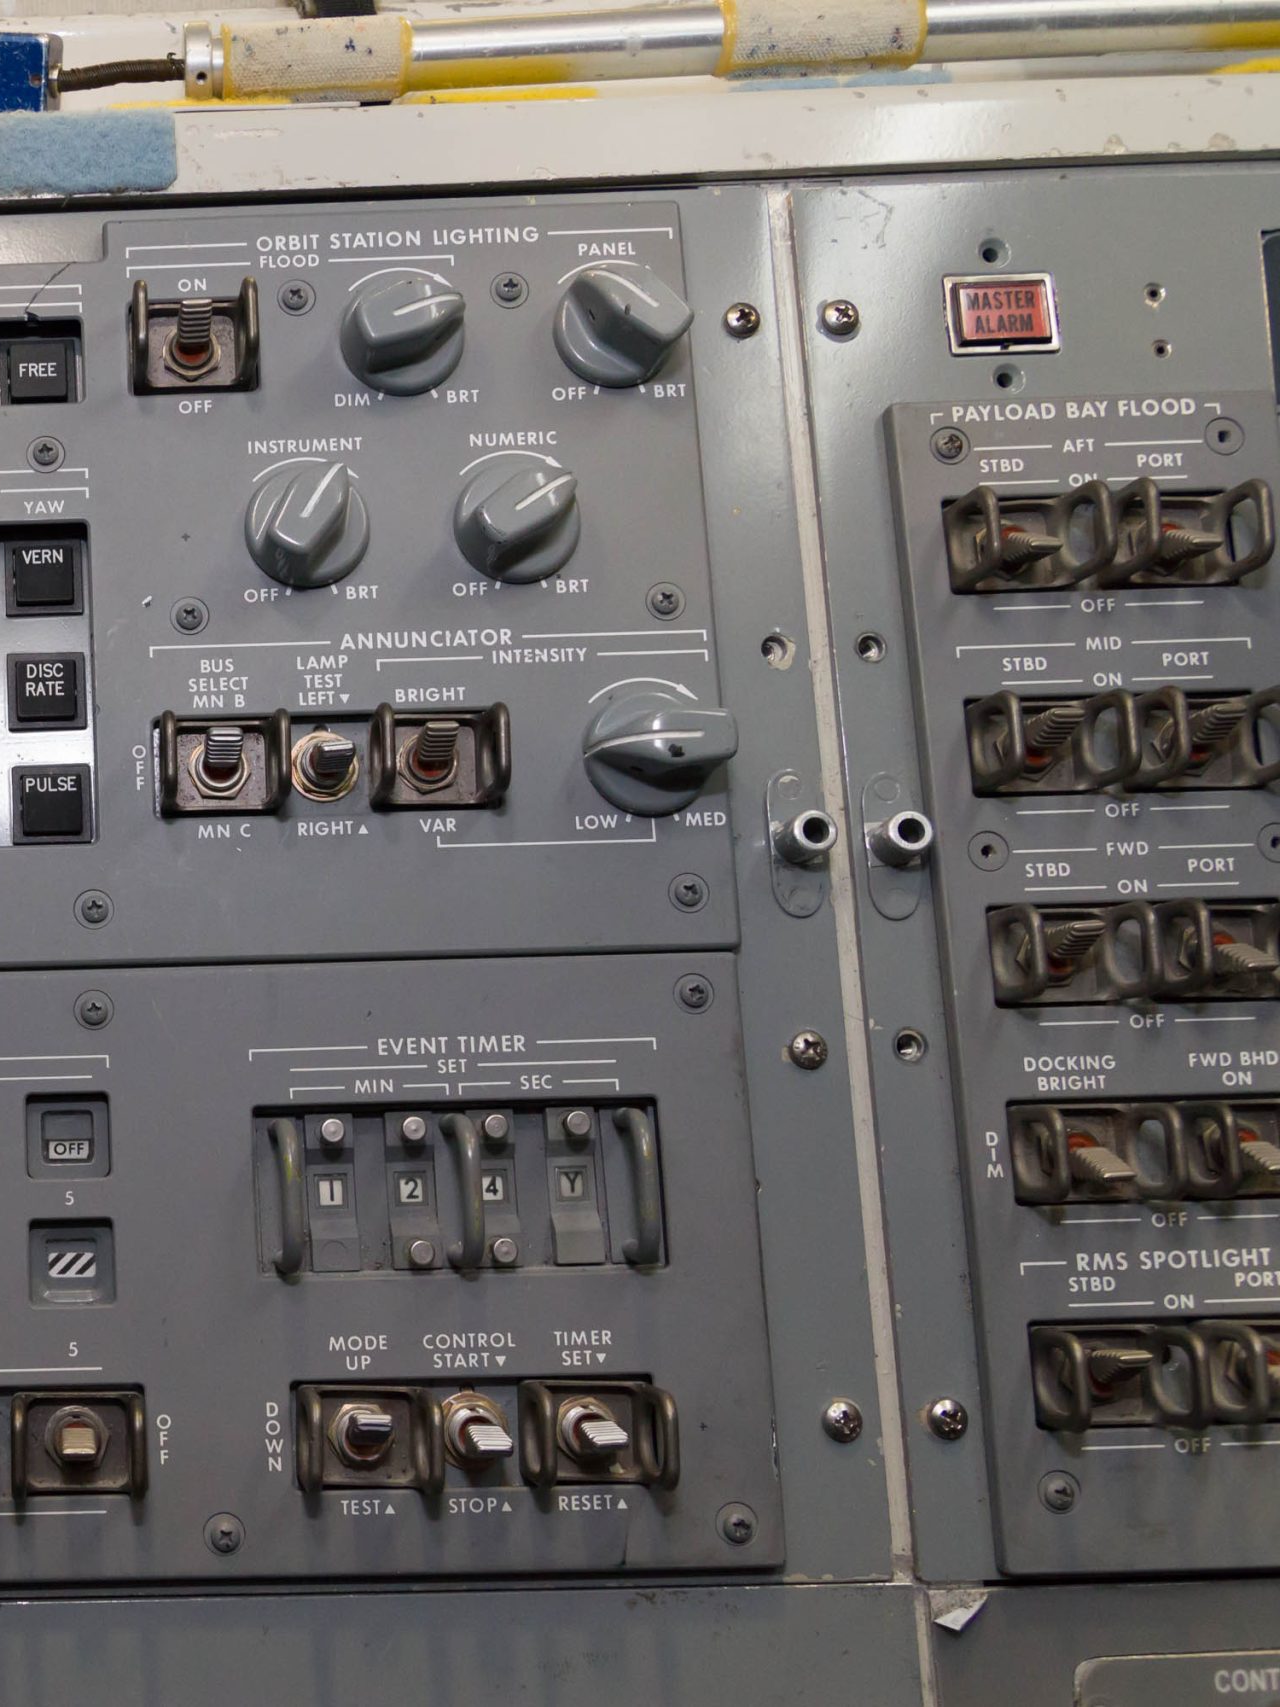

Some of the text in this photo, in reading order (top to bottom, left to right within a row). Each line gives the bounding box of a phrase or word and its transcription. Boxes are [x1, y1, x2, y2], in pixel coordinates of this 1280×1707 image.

[256, 227, 539, 251] ORBIT STATION LIGHTING
[578, 242, 636, 256] PANEL
[260, 255, 319, 269] FLOOD
[177, 278, 207, 292] ON
[966, 291, 1035, 311] MASTER
[975, 314, 1034, 335] ALARM
[19, 362, 57, 377] FREE
[447, 390, 479, 403] BRT
[552, 387, 587, 401] OFF
[654, 384, 686, 398] BRT
[179, 401, 213, 414] OFF
[335, 393, 370, 407] DIM
[952, 399, 1196, 422] PAYLOAD BAY FLOOD
[247, 437, 363, 454] INSTRUMENT
[469, 431, 557, 447] NUMERIC
[1062, 438, 1095, 452] AFT
[979, 459, 1024, 472] STBD
[1137, 453, 1184, 467] PORT
[24, 501, 65, 514] YAW
[22, 549, 63, 564] VERN
[1081, 599, 1116, 612] OFF
[340, 628, 512, 650] ANNUNCIATOR
[1086, 637, 1121, 650] MID
[297, 656, 348, 670] LAMP
[493, 648, 587, 664] INTENSITY
[1162, 652, 1209, 666] PORT
[26, 663, 64, 678] DISC
[200, 659, 234, 673] BUS
[1002, 657, 1047, 671] STBD
[188, 676, 248, 692] SELECT
[304, 674, 343, 688] TEST
[1093, 673, 1122, 686] ON
[25, 681, 65, 696] RATE
[395, 687, 466, 703] BRIGHT
[193, 694, 245, 708] MN B
[299, 692, 334, 706] LEFT
[25, 776, 77, 792] PULSE
[420, 818, 456, 832] VAR
[575, 814, 618, 829] LOW
[686, 812, 726, 826] MED
[298, 821, 354, 836] RIGHT
[1107, 842, 1149, 855] FWD
[1130, 1014, 1165, 1028] OFF
[377, 1035, 526, 1055] EVENT TIMER
[437, 1059, 467, 1073] SET
[1023, 1055, 1116, 1071] DOCKING
[1188, 1050, 1279, 1067] FWD BHD
[520, 1075, 553, 1089] SEC
[1037, 1075, 1106, 1091] BRIGHT
[1222, 1071, 1252, 1085] ON
[354, 1080, 394, 1093] MIN
[54, 1143, 85, 1155] OFF
[404, 1177, 419, 1199] 2
[485, 1175, 498, 1195] 4
[1151, 1212, 1188, 1227] OFF
[1076, 1247, 1270, 1271] RMS SPOTLIGHT
[329, 1335, 388, 1351] MODE
[423, 1332, 516, 1349] CONTROL
[554, 1330, 612, 1346] TIMER
[346, 1356, 371, 1370] UP
[433, 1353, 490, 1368] START
[562, 1350, 592, 1365] SET
[265, 1402, 284, 1471] DOWN
[1174, 1438, 1211, 1453] OFF
[341, 1500, 380, 1515] TEST
[449, 1498, 497, 1513] STOP
[558, 1496, 611, 1511] RESET
